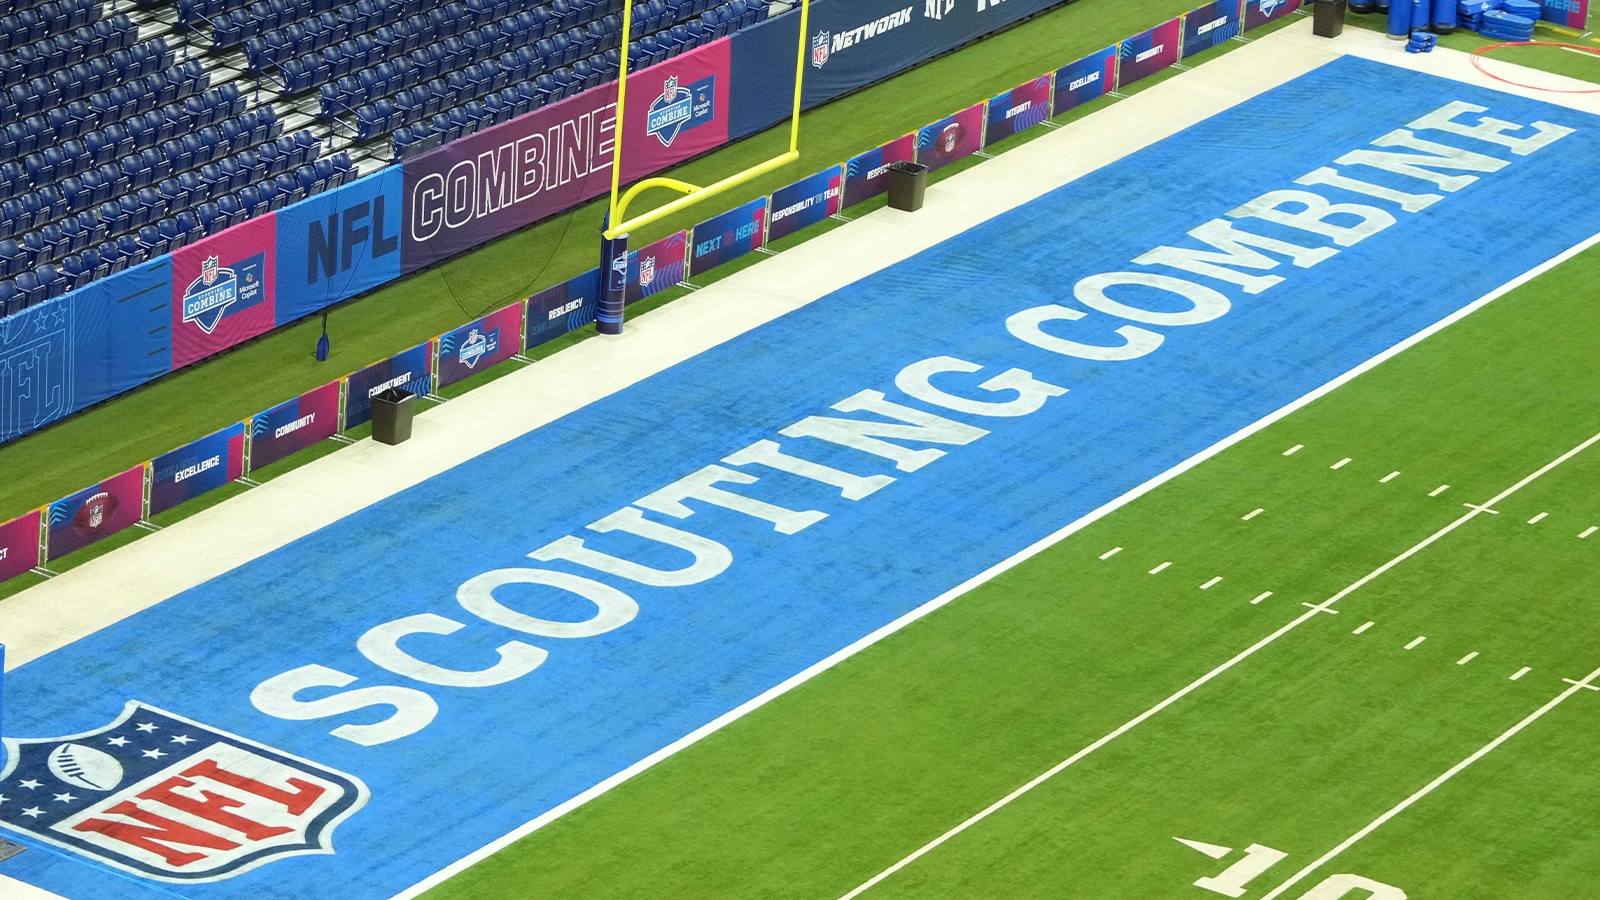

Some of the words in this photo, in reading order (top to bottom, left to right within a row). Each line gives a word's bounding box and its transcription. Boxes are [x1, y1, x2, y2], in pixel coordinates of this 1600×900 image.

[813, 46, 827, 63] NFL
[830, 6, 914, 54] NETWORK
[1069, 71, 1100, 91] EXCELLENCE
[665, 87, 676, 101] NFL
[651, 106, 688, 128] COMBINE
[1005, 100, 1032, 119] INTEGRITY
[307, 194, 399, 286] NFL
[411, 102, 618, 242] COMBINE
[771, 196, 815, 223] RESPONSIBILITY
[823, 186, 839, 200] TEAM
[695, 235, 723, 259] NEXT
[735, 218, 760, 242] HERE
[204, 268, 217, 282] NFL
[239, 280, 260, 294] Microsoft
[641, 269, 654, 284] NFL
[187, 287, 232, 314] COMBINE
[241, 289, 258, 300] Copilot
[548, 297, 584, 321] RESILIENCY
[249, 356, 1071, 747] SCOUTING
[1005, 100, 1578, 361] COMBINE
[275, 412, 316, 439] COMMUNITY
[174, 455, 220, 484] EXCELLENCE
[71, 758, 327, 868] NFL
